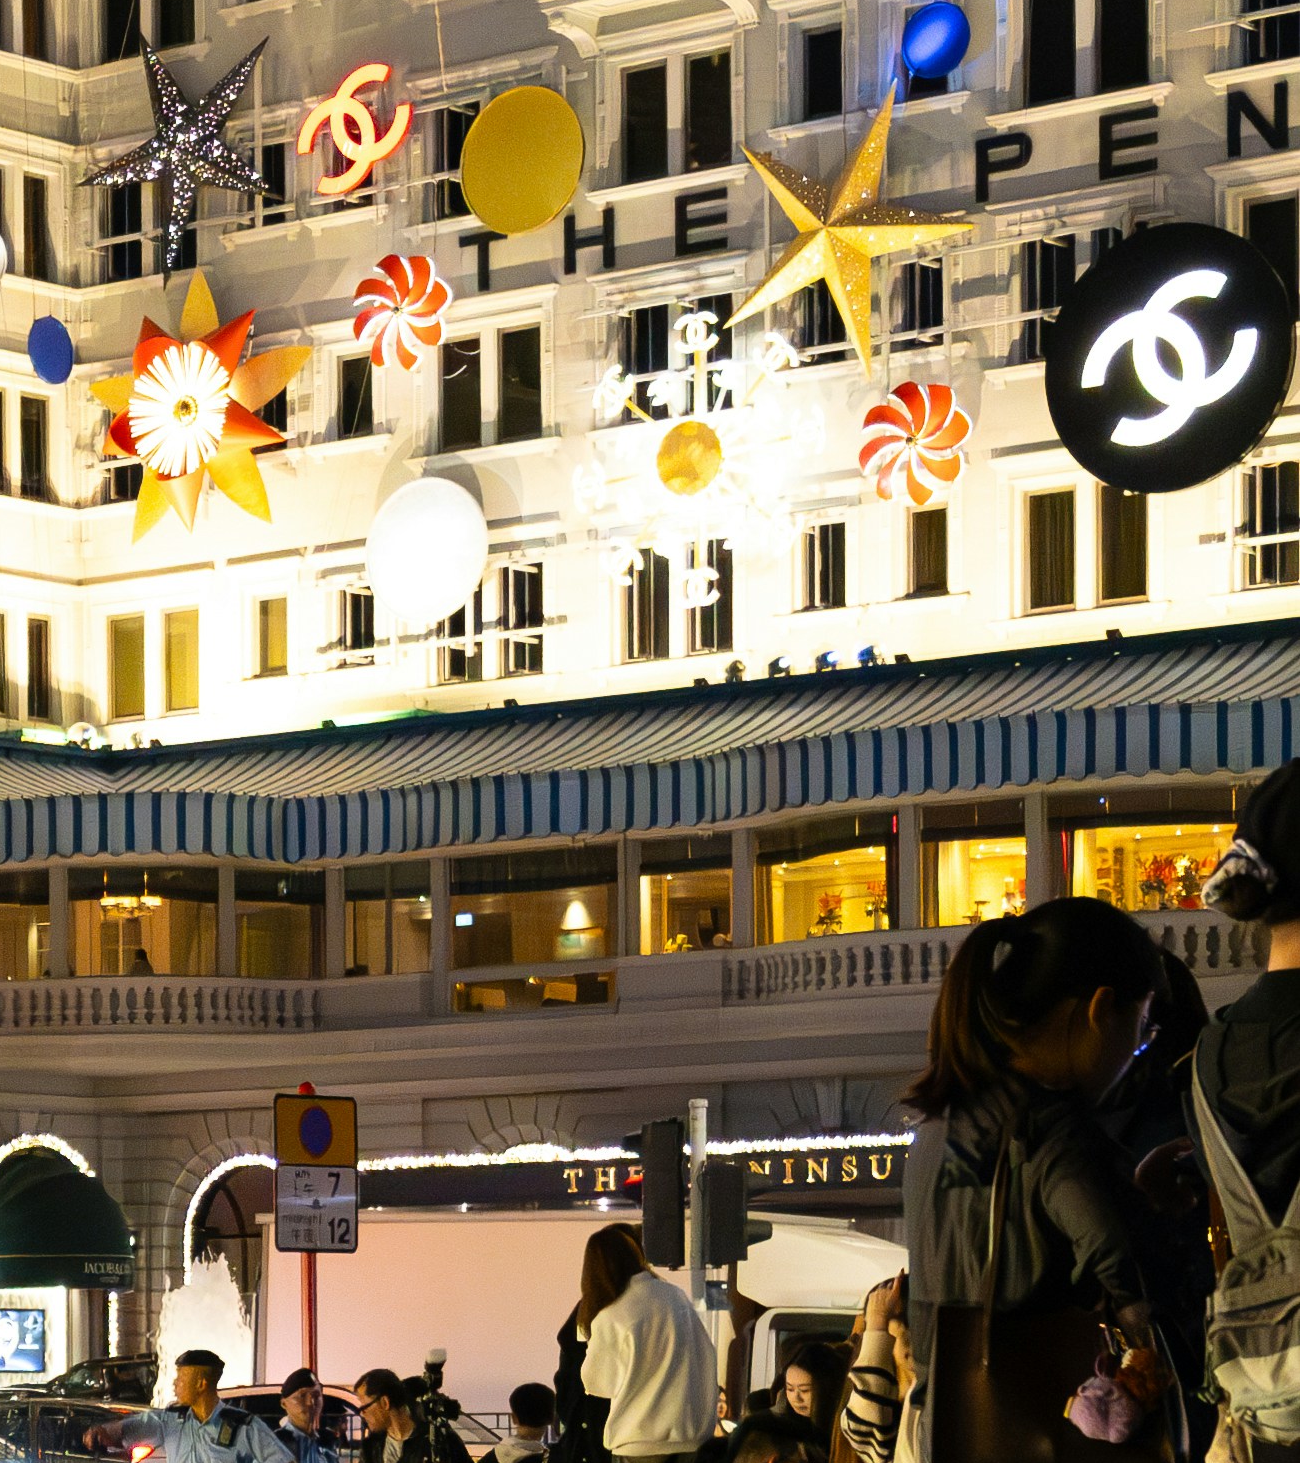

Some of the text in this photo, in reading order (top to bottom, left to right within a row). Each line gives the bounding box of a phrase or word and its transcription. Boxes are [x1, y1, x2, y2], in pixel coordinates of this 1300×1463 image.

[458, 80, 1290, 292] THE PEN
[327, 1171, 341, 1198] 7
[327, 1217, 351, 1244] 12
